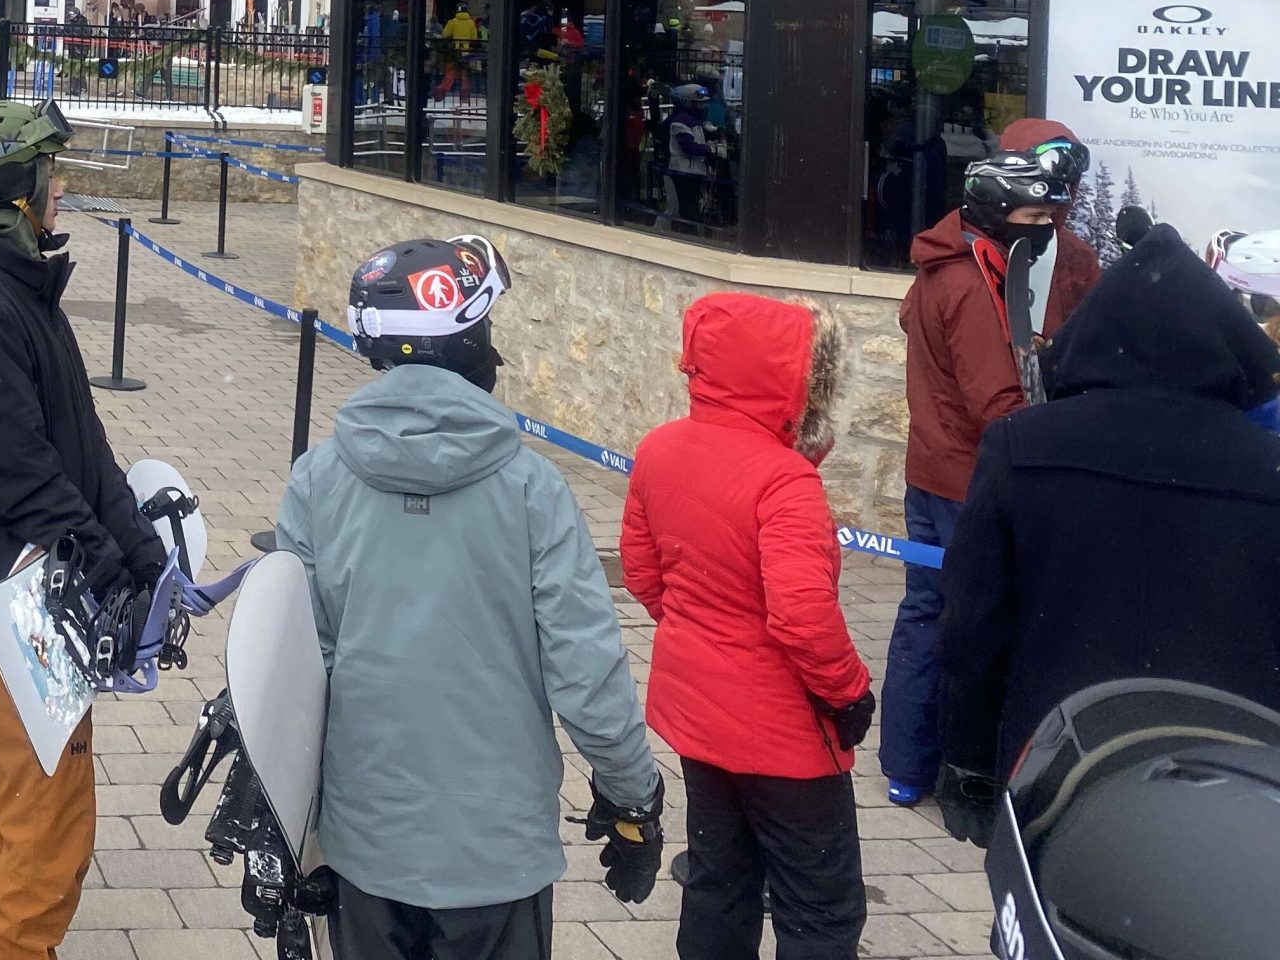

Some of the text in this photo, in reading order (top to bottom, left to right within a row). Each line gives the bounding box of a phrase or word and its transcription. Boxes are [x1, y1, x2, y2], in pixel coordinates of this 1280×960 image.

[1137, 25, 1229, 36] OAKLEY
[1117, 47, 1251, 78] DRAW
[1074, 75, 1280, 109] YOUR LINE
[1130, 107, 1233, 123] Be Who You Are
[1081, 138, 1101, 146] AMIE
[1103, 138, 1152, 148] ANDERSON
[1164, 141, 1199, 150] OAKLEY
[1202, 143, 1229, 151] SNOW
[1142, 149, 1218, 160] SNOWBOARDING
[531, 421, 548, 438] VAIL
[609, 453, 628, 472] VAIL
[855, 531, 898, 554] VAIL
[71, 741, 87, 756] HH
